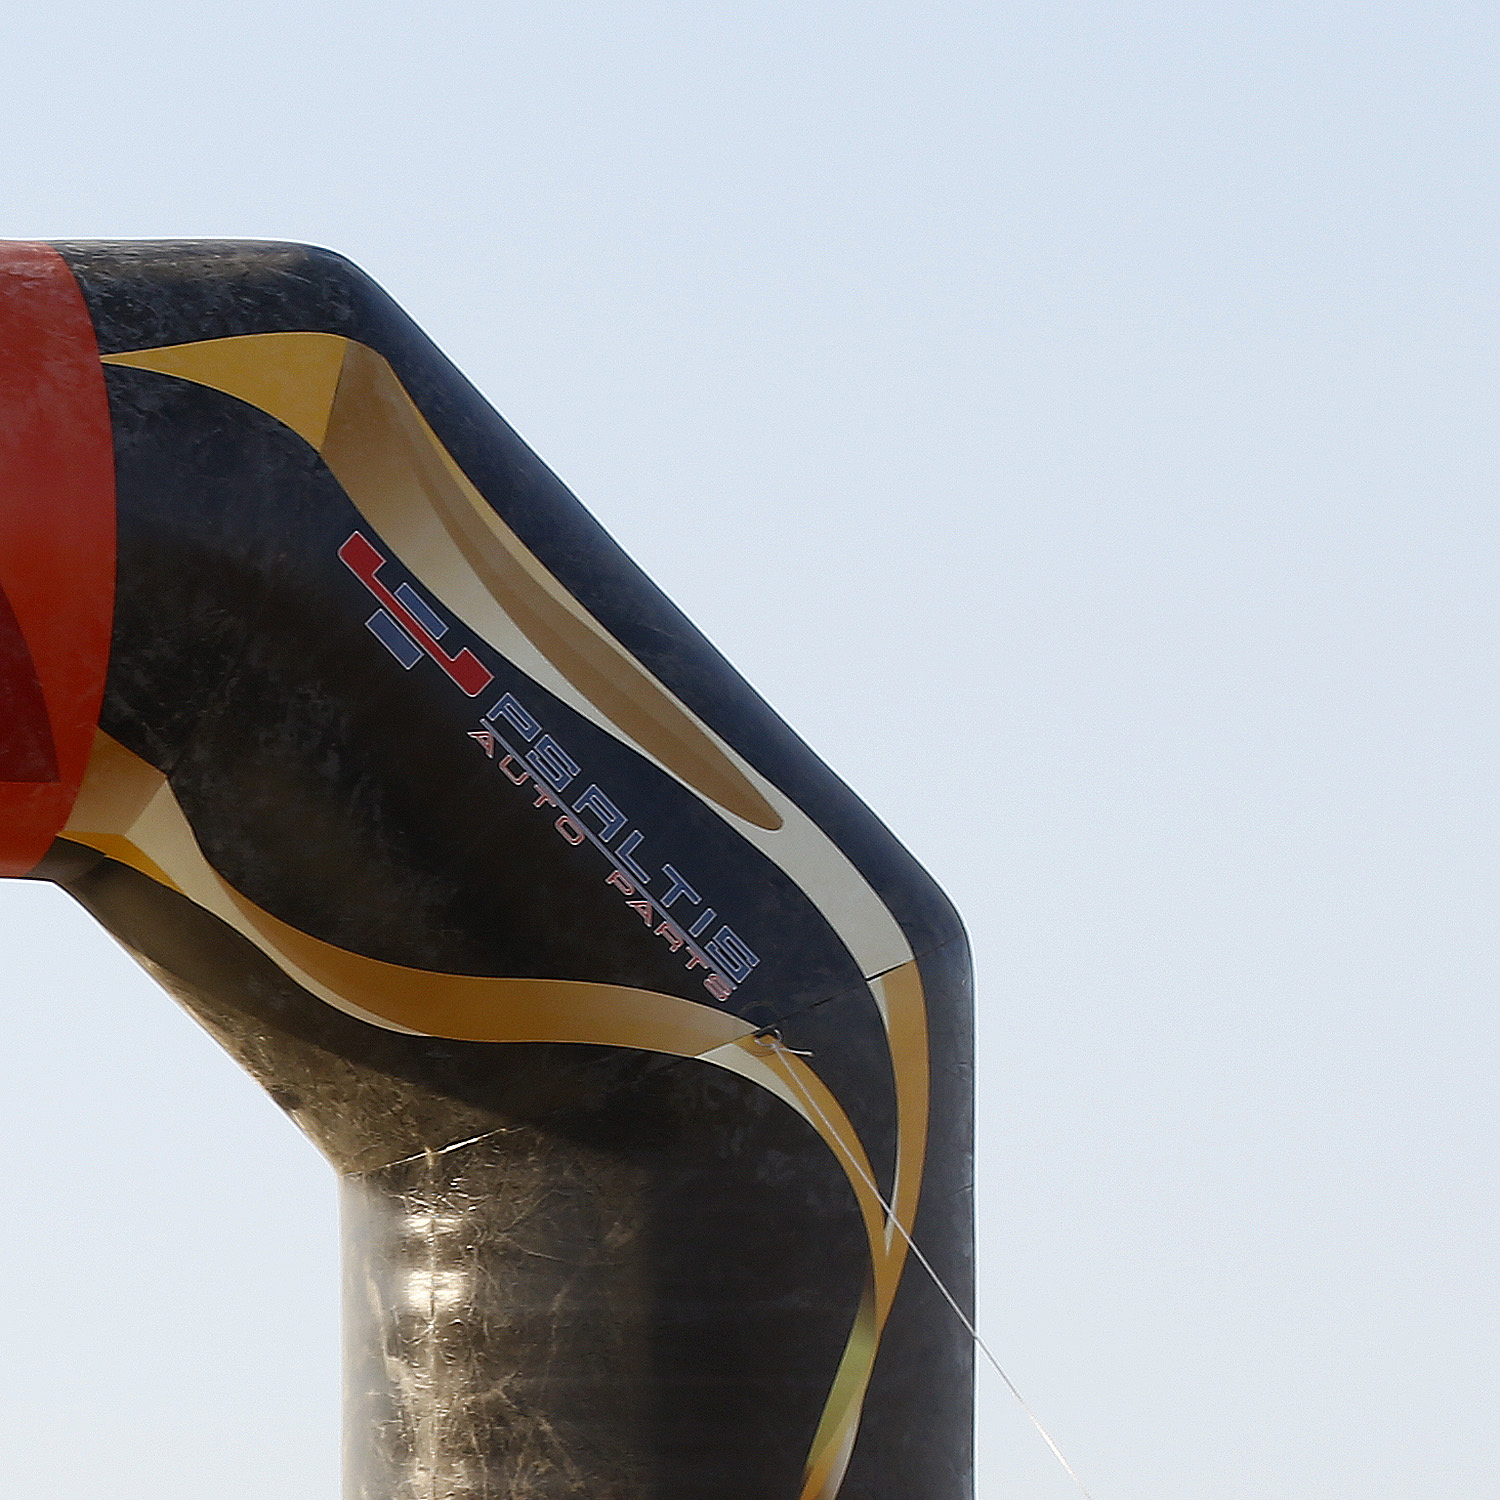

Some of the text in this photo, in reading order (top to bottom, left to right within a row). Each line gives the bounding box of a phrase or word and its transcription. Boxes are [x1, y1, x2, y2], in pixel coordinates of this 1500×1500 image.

[466, 730, 738, 1002] AUTO PARTS
[484, 692, 762, 985] PSALTIS
